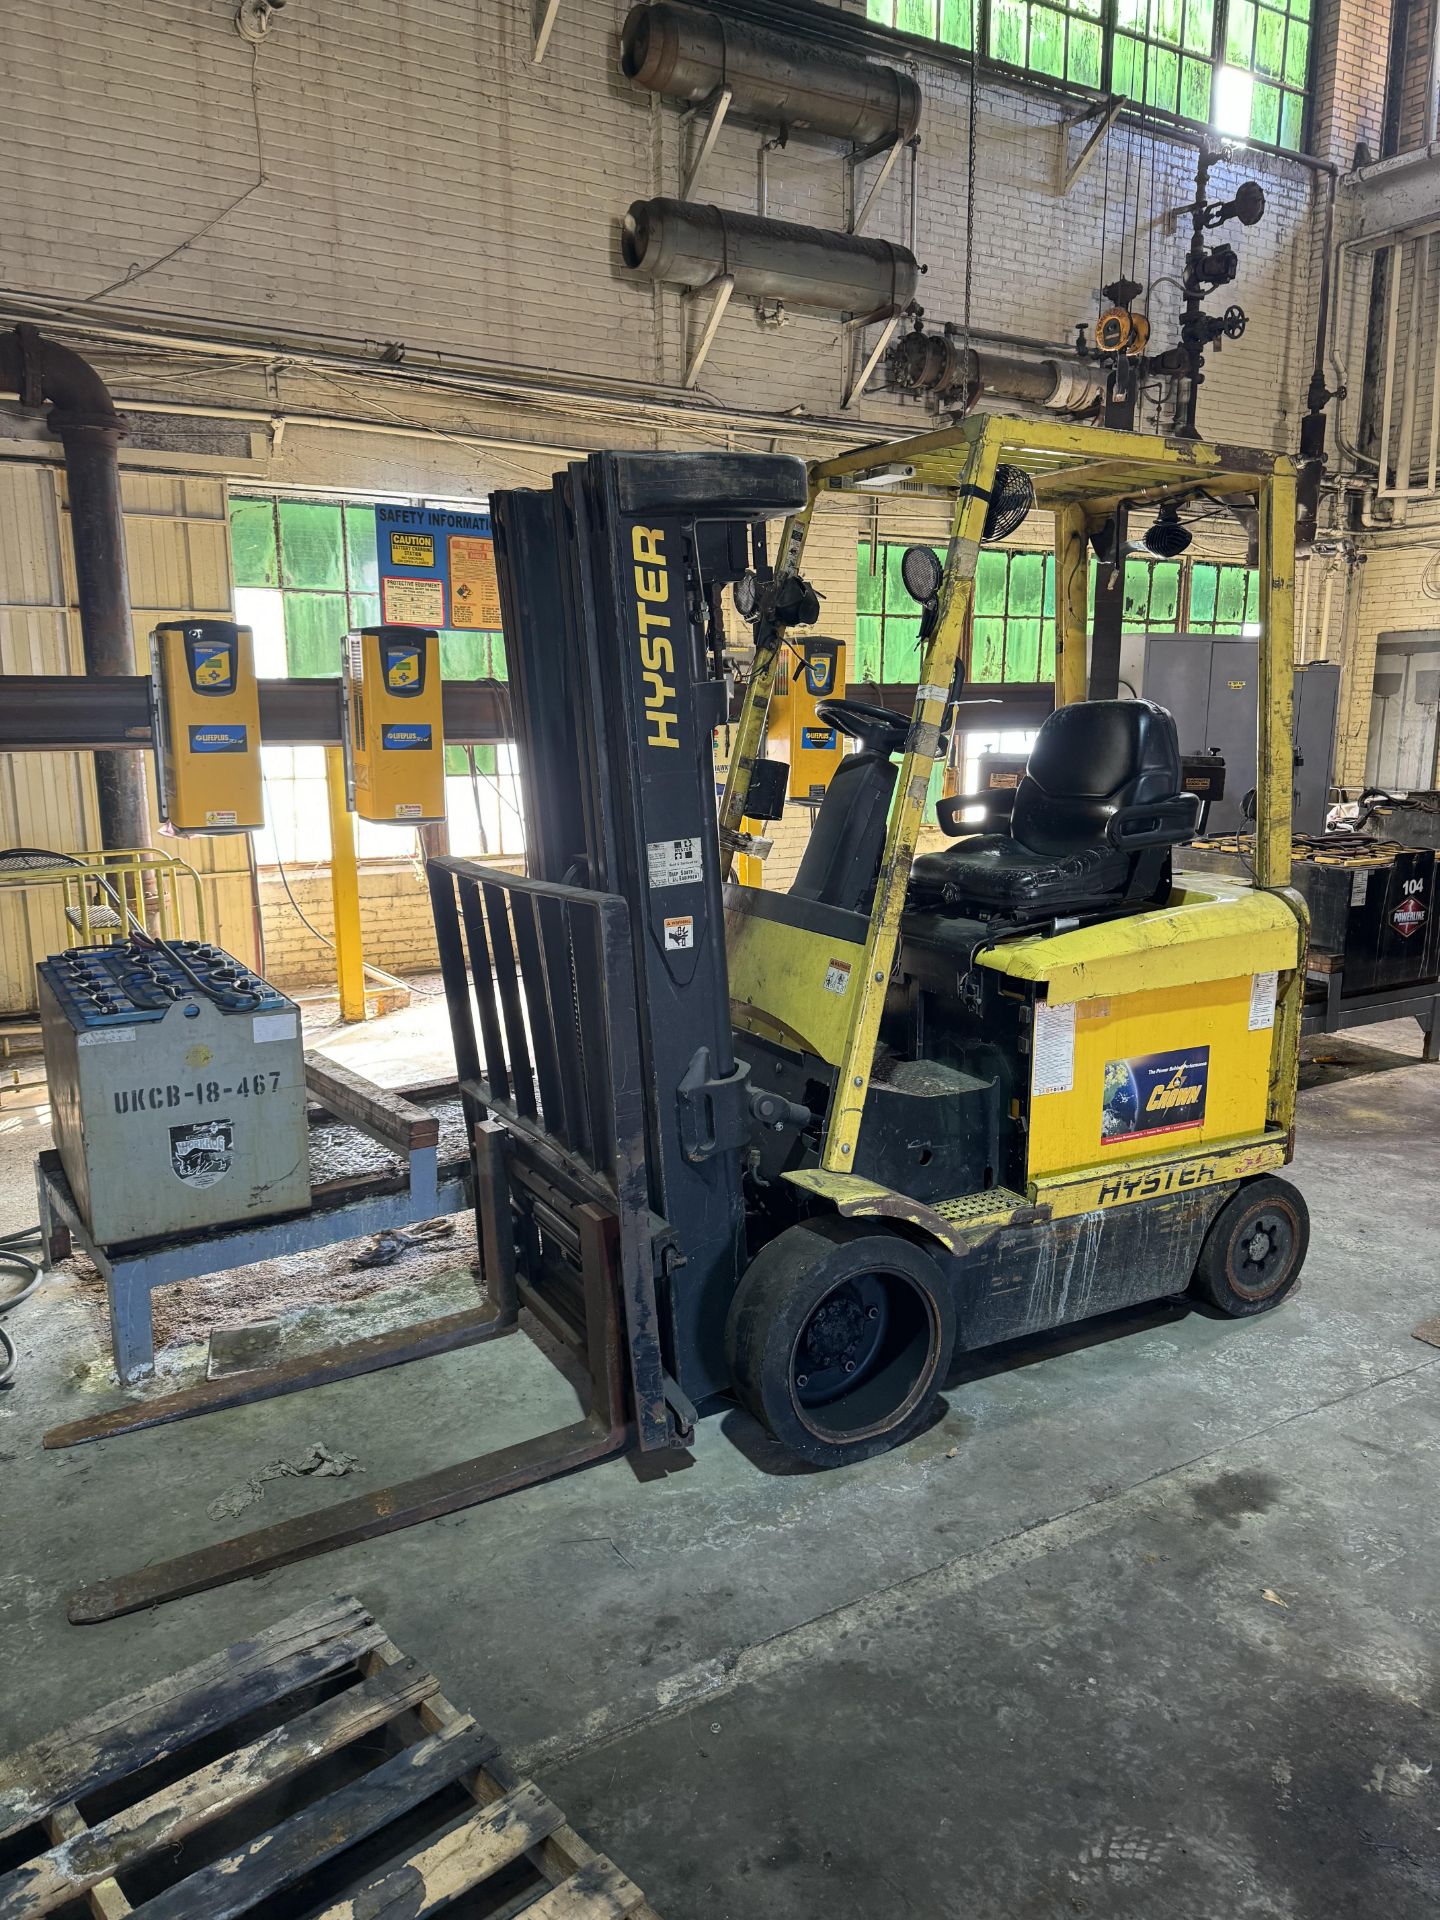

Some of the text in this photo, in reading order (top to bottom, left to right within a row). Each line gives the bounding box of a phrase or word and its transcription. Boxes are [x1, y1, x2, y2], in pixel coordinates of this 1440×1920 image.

[380, 508, 492, 530] SAFETY INFORMATI
[393, 534, 431, 546] CAUTION
[387, 579, 440, 589] PROTECTIVE EQUIPMENT
[632, 525, 680, 749] HYSTER
[202, 734, 229, 742] LIFEPLUS
[393, 732, 416, 740] LIFEPLUS
[1402, 878, 1424, 896] 104
[1155, 1066, 1169, 1074] Power
[113, 1071, 281, 1115] UKCB-18-467
[175, 1135, 225, 1155] WORKHOG
